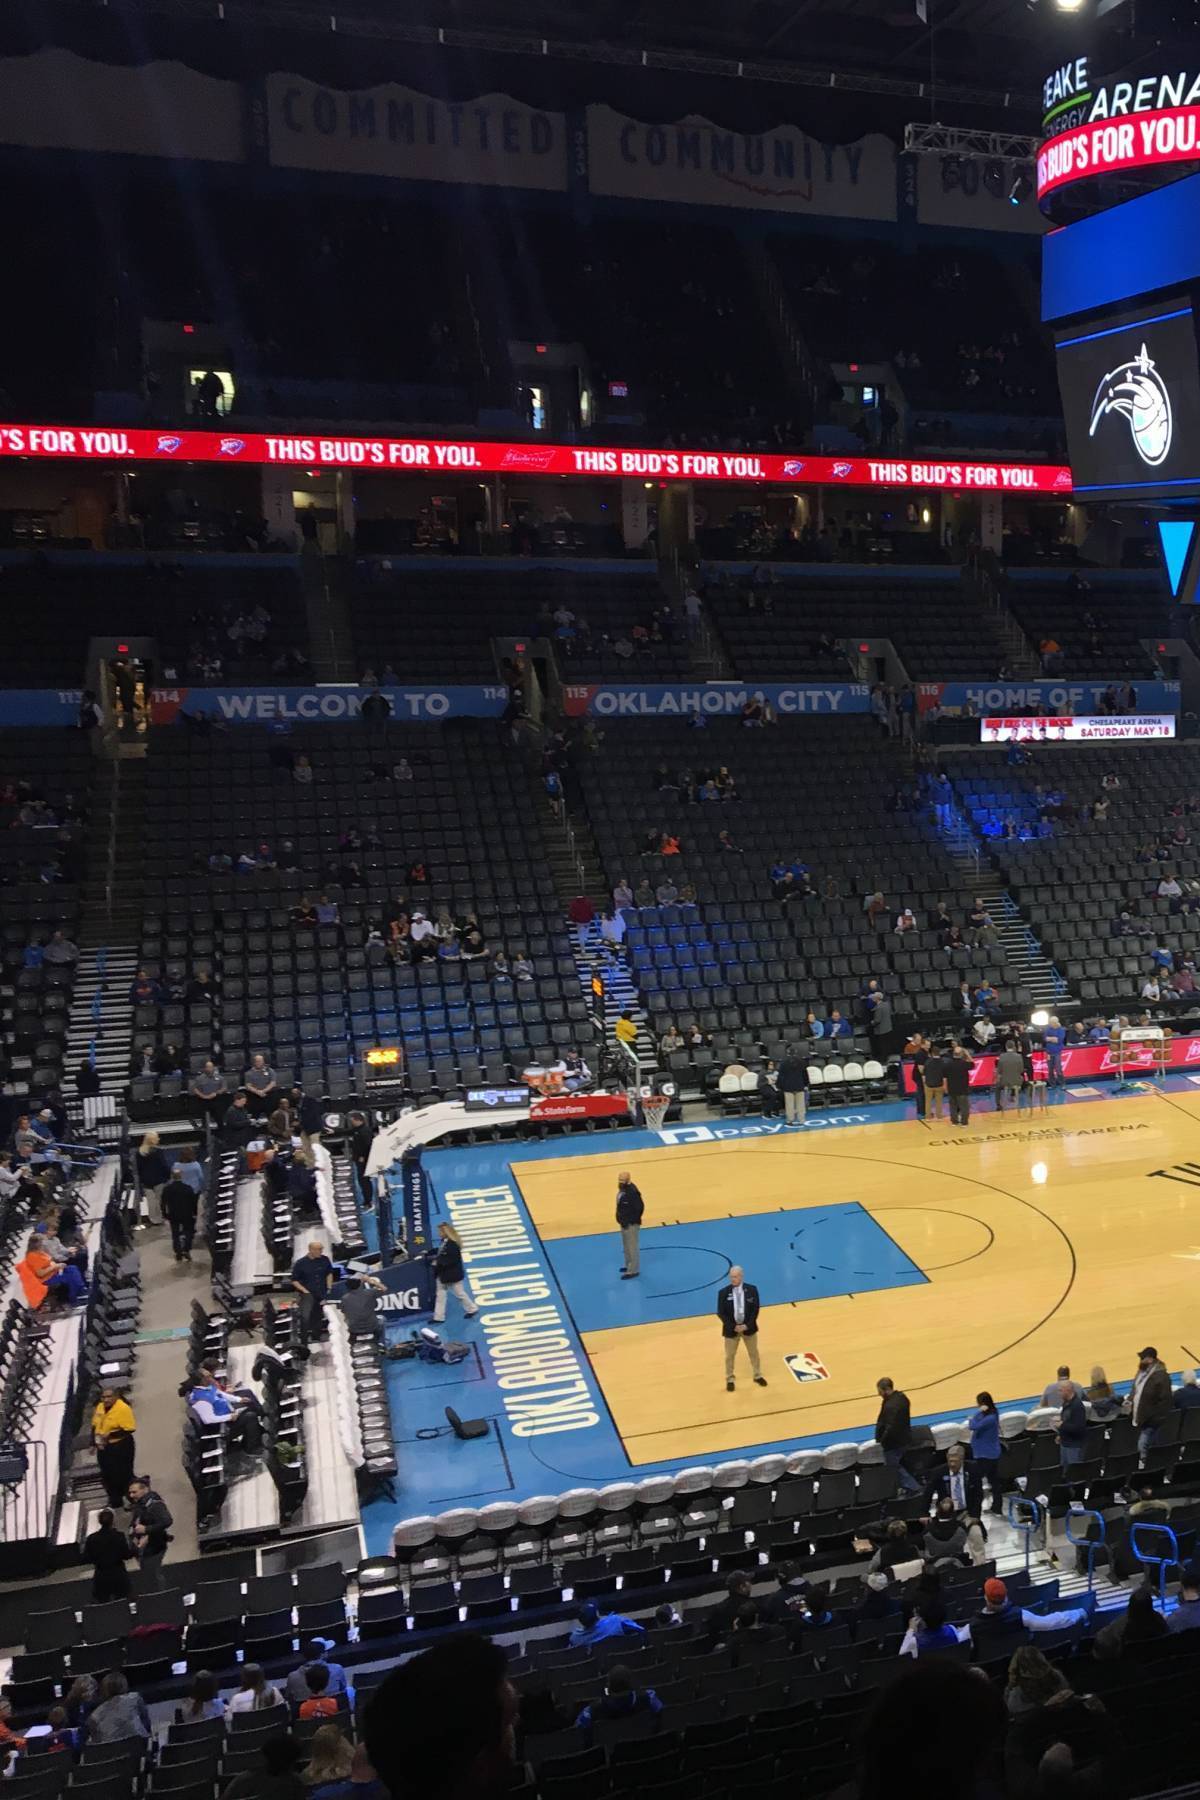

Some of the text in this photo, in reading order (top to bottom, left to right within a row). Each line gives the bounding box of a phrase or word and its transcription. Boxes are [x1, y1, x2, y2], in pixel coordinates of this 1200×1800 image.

[1043, 56, 1089, 109] EAKE
[282, 88, 554, 155] COMMITTED
[620, 121, 864, 185] COMMUNITY
[1047, 134, 1089, 181] BUD'S
[1092, 123, 1135, 165] FOR
[30, 429, 76, 453] FOR
[80, 433, 135, 455] YOU.
[265, 438, 316, 461] THIS
[319, 440, 385, 464] BUD'S
[389, 444, 431, 465] FOR
[433, 446, 482, 467] YOU.
[572, 450, 618, 471] THIS
[621, 452, 679, 475] BUD'S
[683, 455, 718, 476] FOR
[722, 457, 766, 478] YOU.
[868, 462, 908, 482] THIS
[911, 464, 962, 485] BUD'S
[966, 466, 997, 486] FOR
[1000, 468, 1038, 488] YOU.
[152, 690, 181, 703] 114
[482, 687, 506, 699] 114
[566, 687, 588, 699] 115
[849, 684, 870, 696] 115
[919, 685, 938, 696] 116
[966, 687, 1042, 709] HOME
[1048, 687, 1084, 708] OF
[1163, 682, 1180, 692] 116
[403, 692, 451, 716] TO
[778, 690, 845, 712] CITY
[1081, 726, 1169, 737] SATURDAY MAY 18
[1138, 718, 1162, 726] ARENA
[928, 1127, 1067, 1147] CHESAPEAKE
[1018, 1122, 1150, 1143] ENERGY ARENA
[411, 1172, 423, 1232] DRAFTKINGS
[445, 1185, 535, 1263] THUNDER
[466, 1263, 551, 1307] CITY
[479, 1305, 601, 1438] OKLAHOMA
